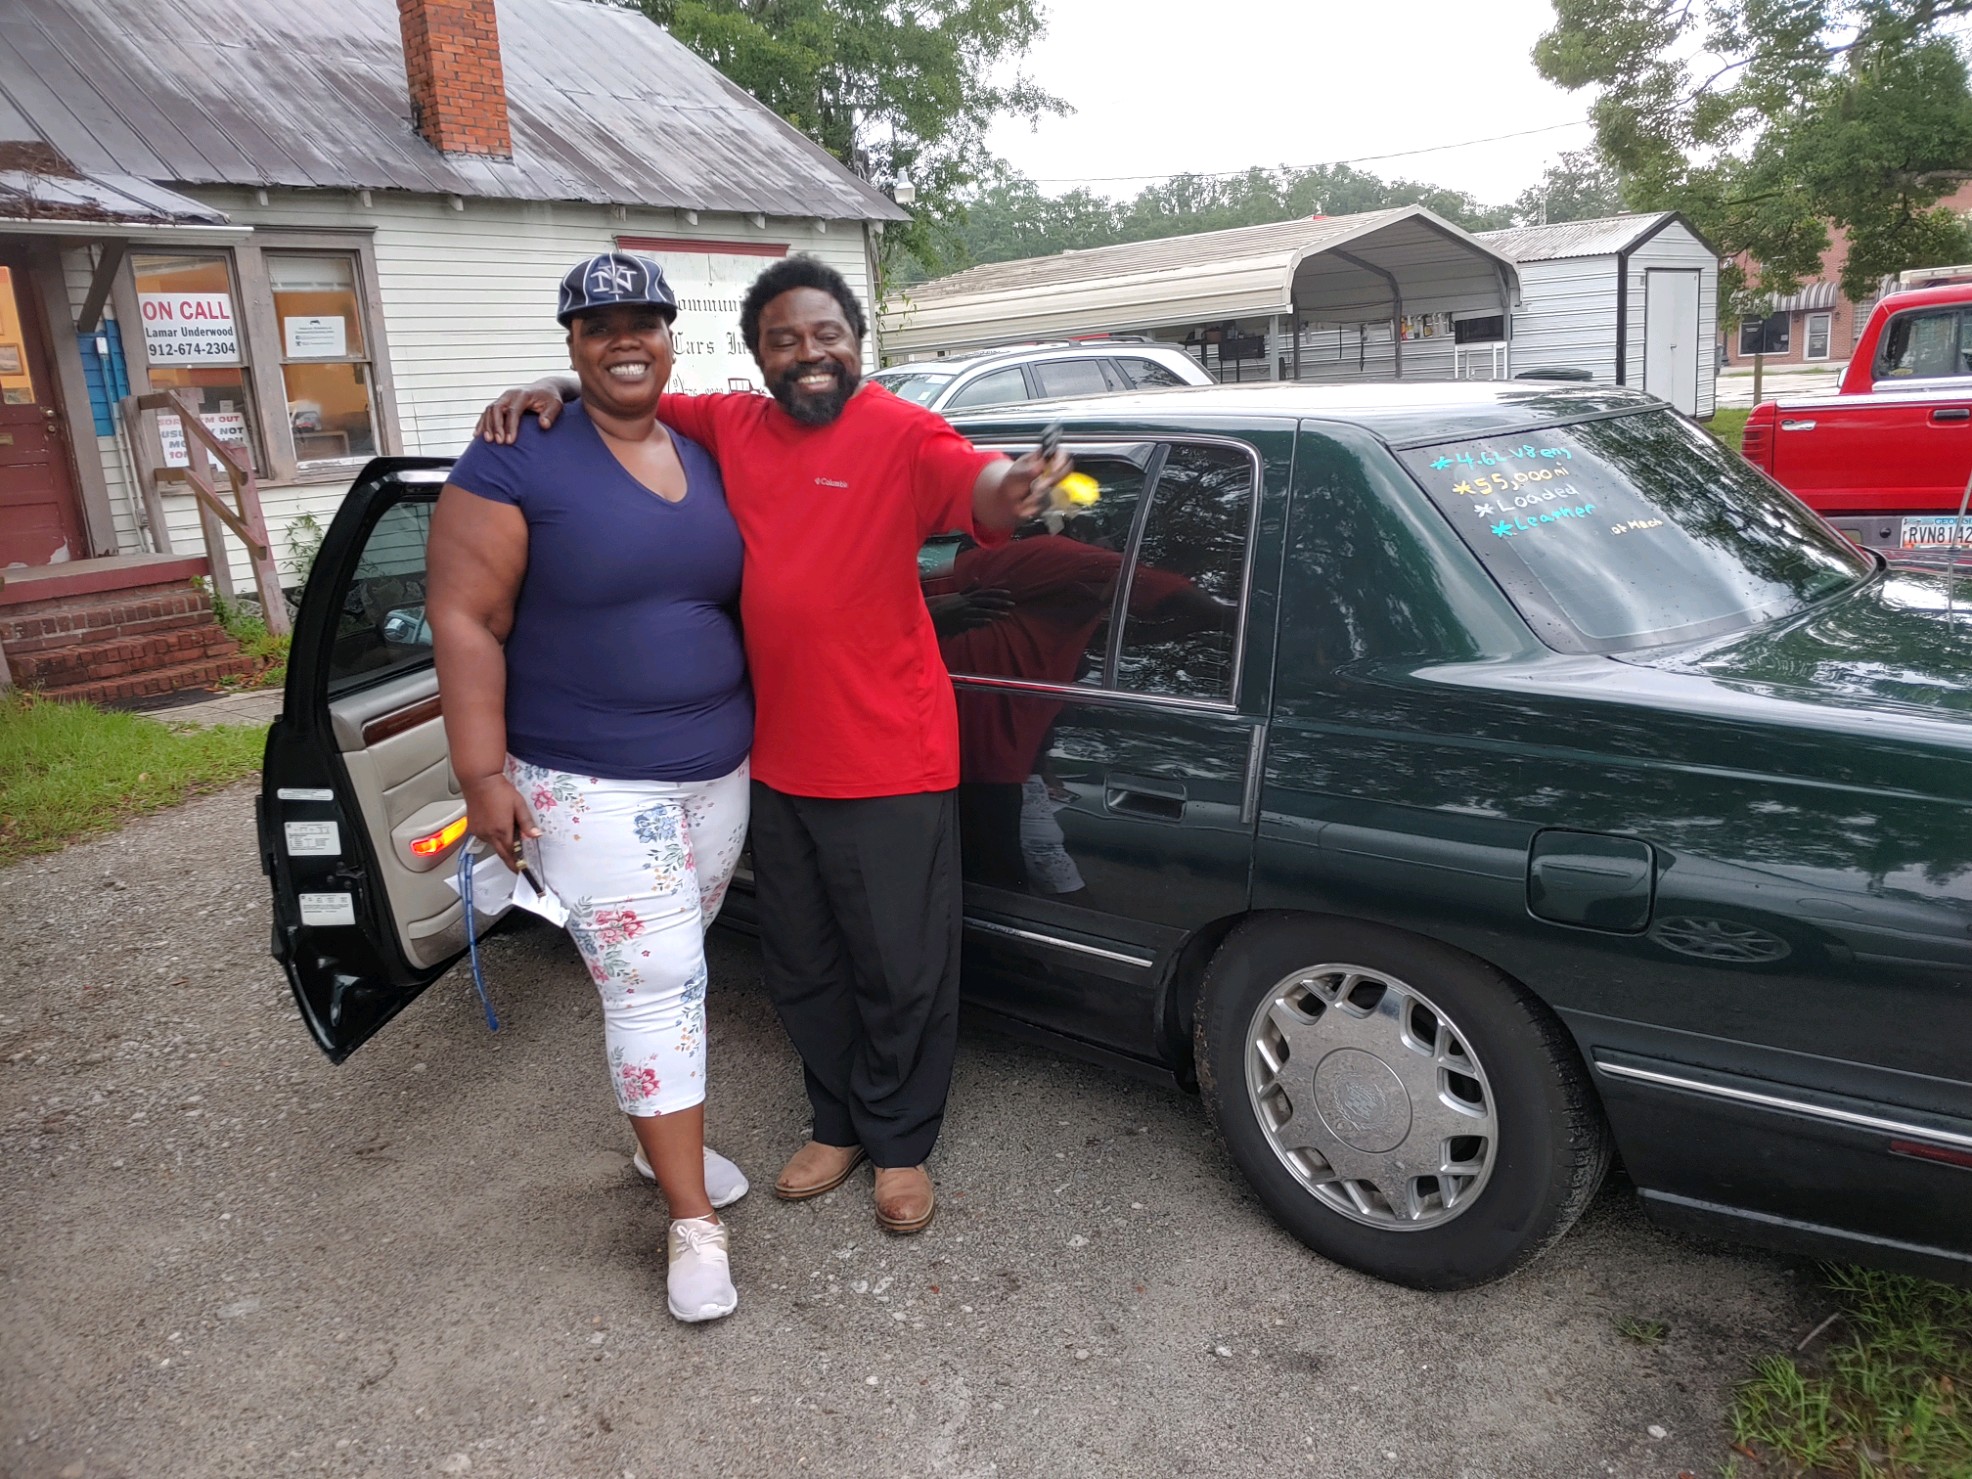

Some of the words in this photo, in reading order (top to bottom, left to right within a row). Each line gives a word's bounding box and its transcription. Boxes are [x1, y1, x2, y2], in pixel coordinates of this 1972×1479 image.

[590, 265, 637, 294] NY
[143, 301, 173, 321] ON
[180, 300, 230, 320] CALL
[146, 327, 177, 338] Lamar
[181, 326, 233, 338] Underwood
[149, 342, 236, 356] 912-674-2304
[673, 331, 715, 355] Cars
[220, 427, 244, 435] NOT
[1509, 444, 1536, 459] V8
[1474, 468, 1553, 495] 55,000
[1554, 461, 1569, 477] mi
[1497, 484, 1580, 513] Loaded
